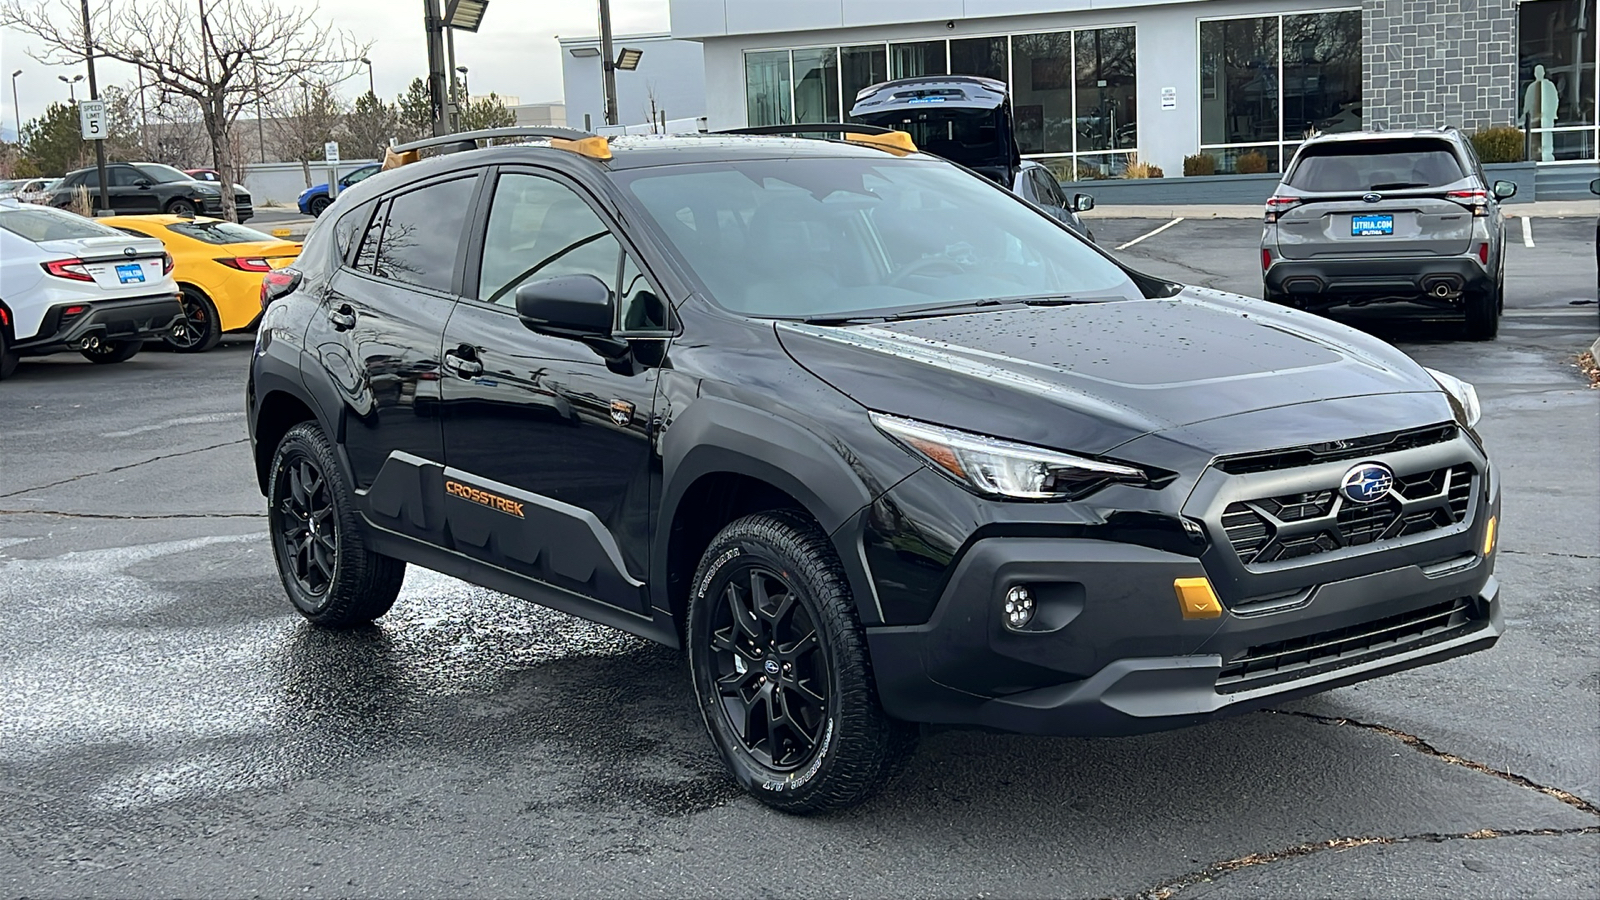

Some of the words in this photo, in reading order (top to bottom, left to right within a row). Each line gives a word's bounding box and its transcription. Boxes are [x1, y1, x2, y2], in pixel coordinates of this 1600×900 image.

[90, 120, 99, 134] 5
[1352, 220, 1392, 230] LITHIA.COM
[445, 480, 525, 518] CROSSTREK
[697, 547, 741, 599] YOKOHAMA
